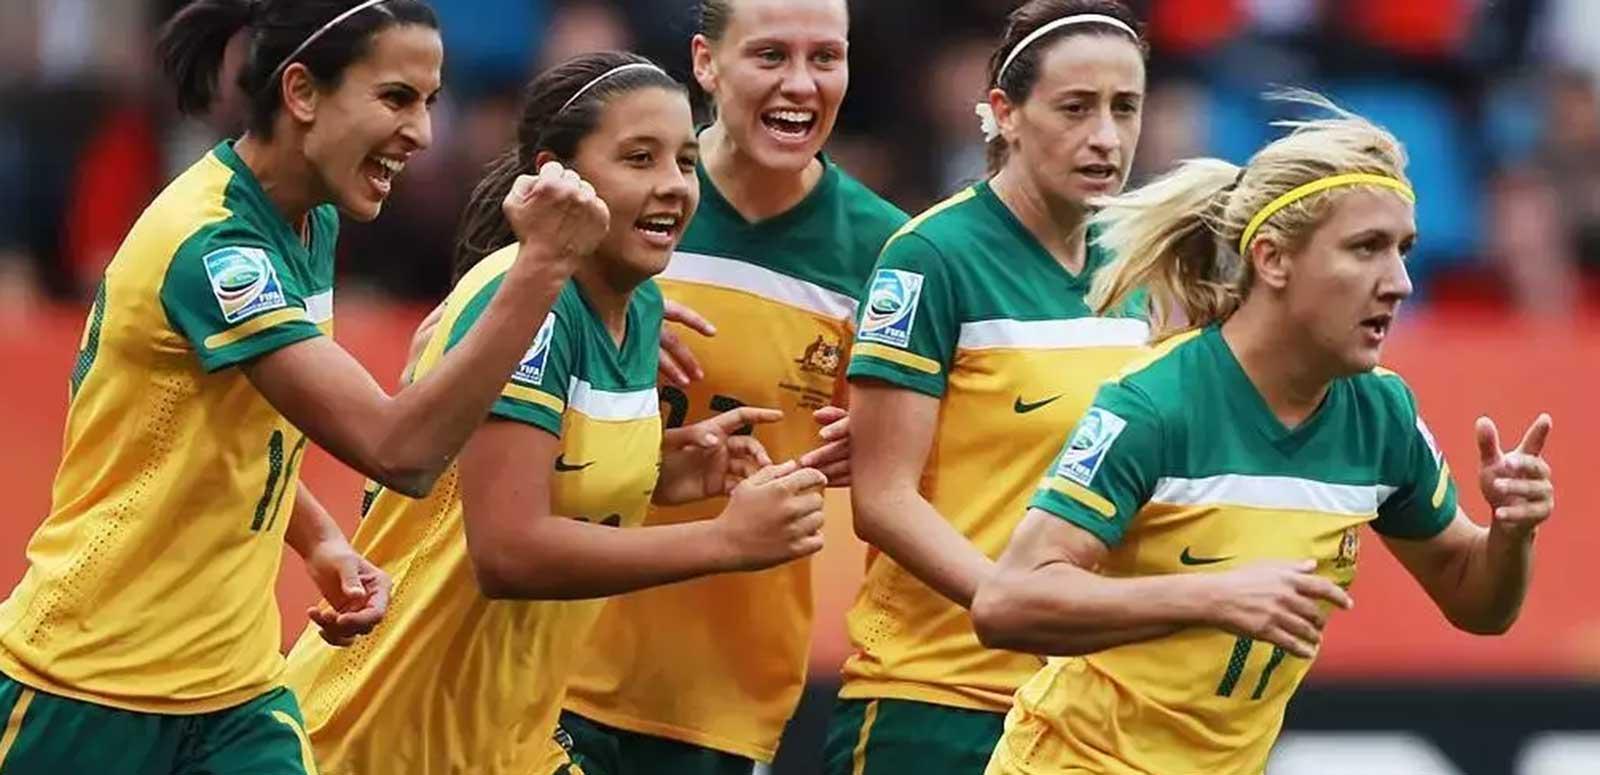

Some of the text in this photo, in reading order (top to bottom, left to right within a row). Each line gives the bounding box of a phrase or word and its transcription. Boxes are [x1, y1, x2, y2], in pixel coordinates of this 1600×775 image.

[259, 291, 279, 303] FIFA
[885, 326, 906, 338] FIFA
[519, 364, 540, 377] FIFA
